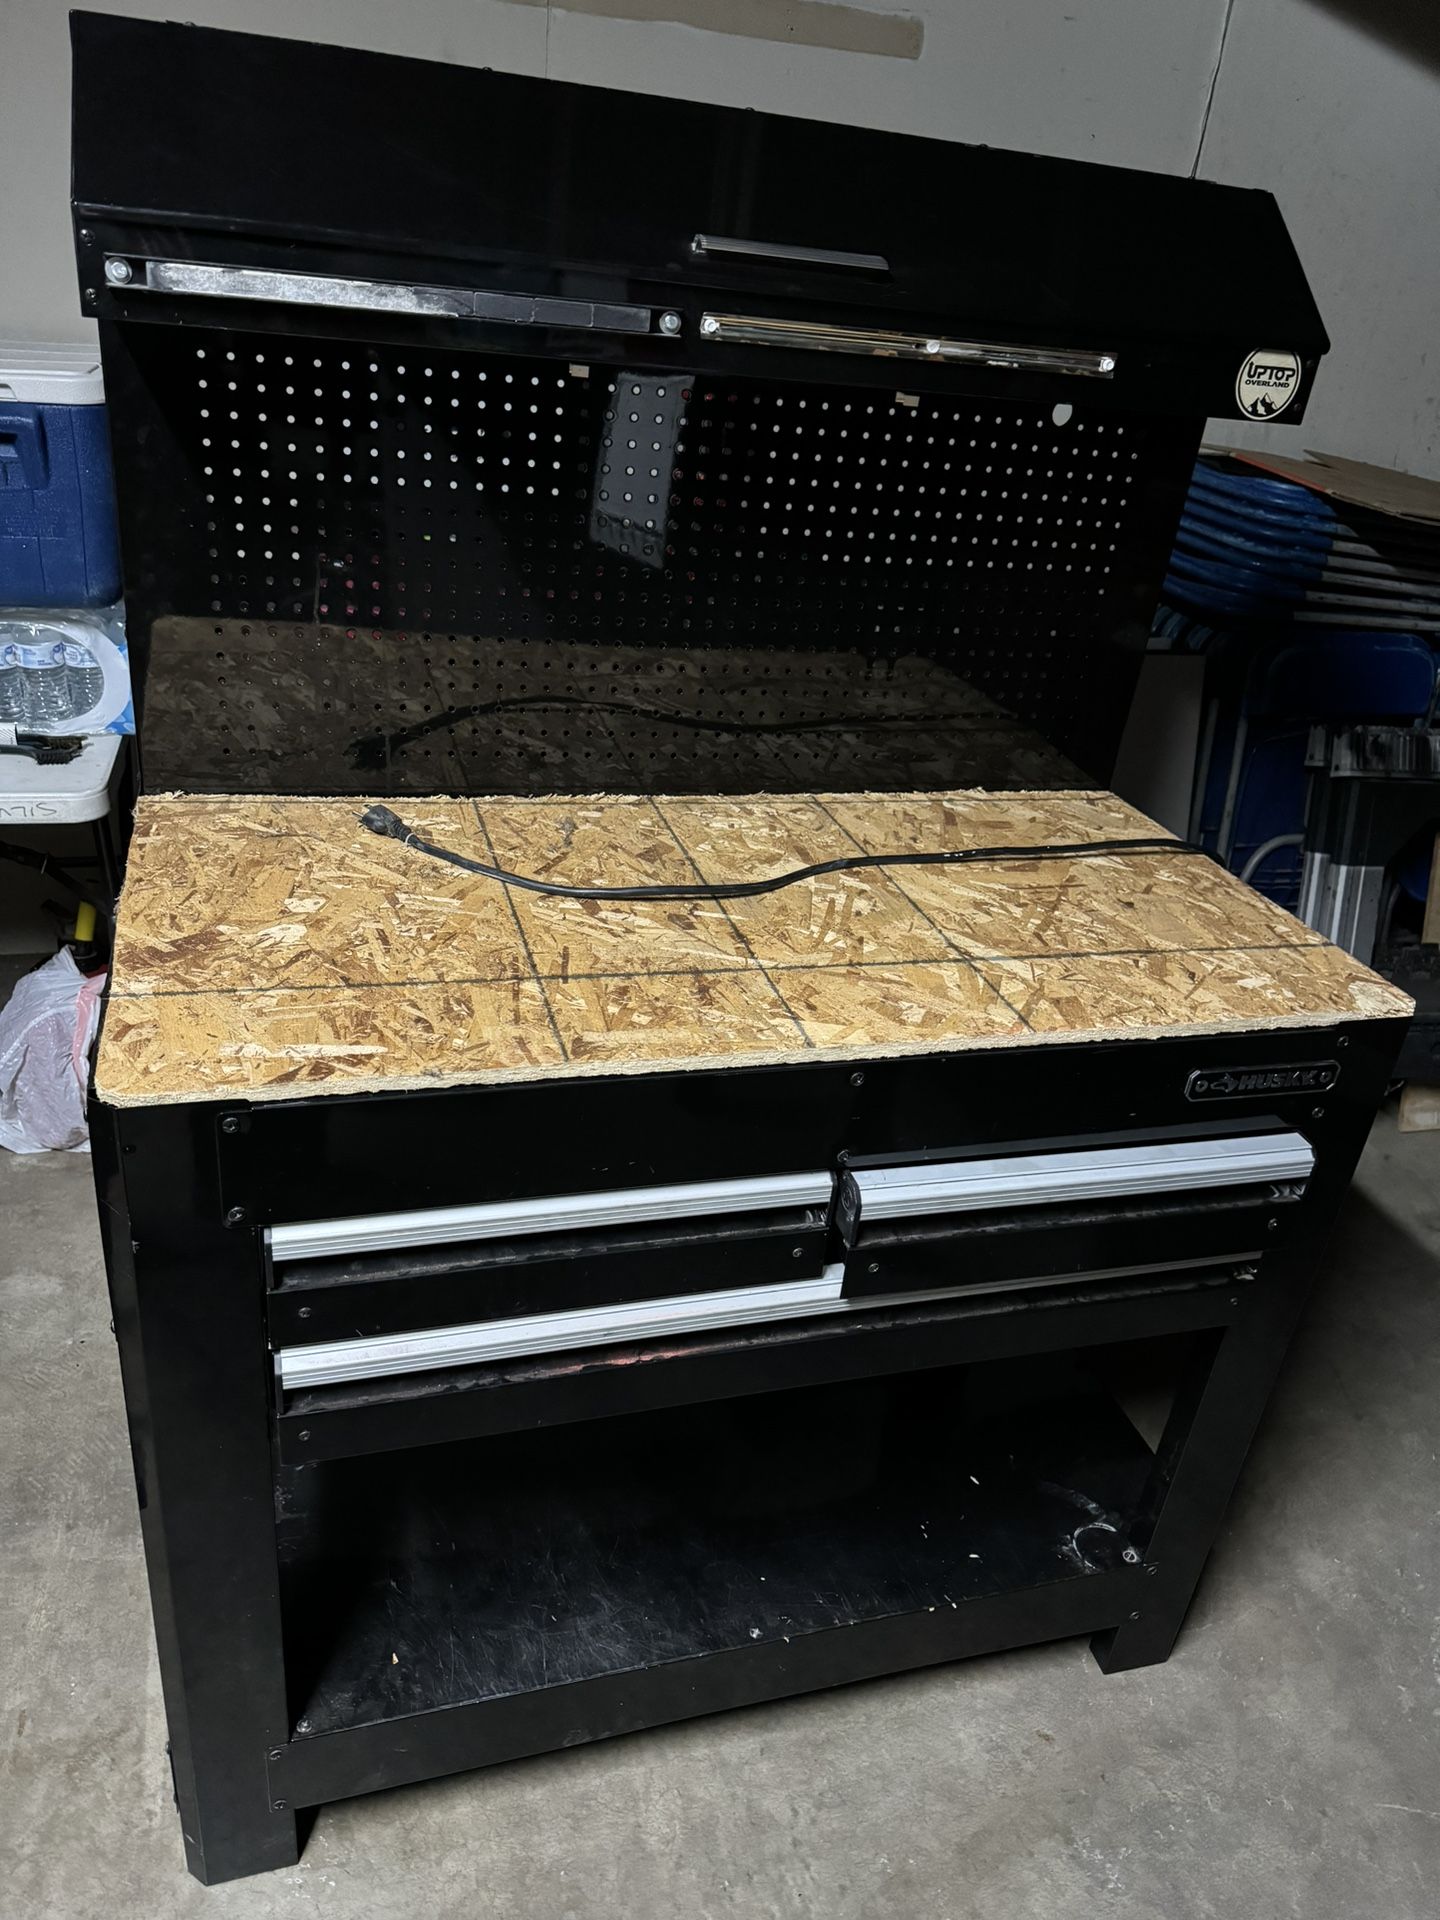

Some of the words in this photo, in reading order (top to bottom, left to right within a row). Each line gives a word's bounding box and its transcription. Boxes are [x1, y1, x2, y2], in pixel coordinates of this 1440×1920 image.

[1247, 360, 1296, 381] UPTOP
[1245, 379, 1290, 388] OVERLAND
[1238, 1070, 1318, 1091] HUSKY
